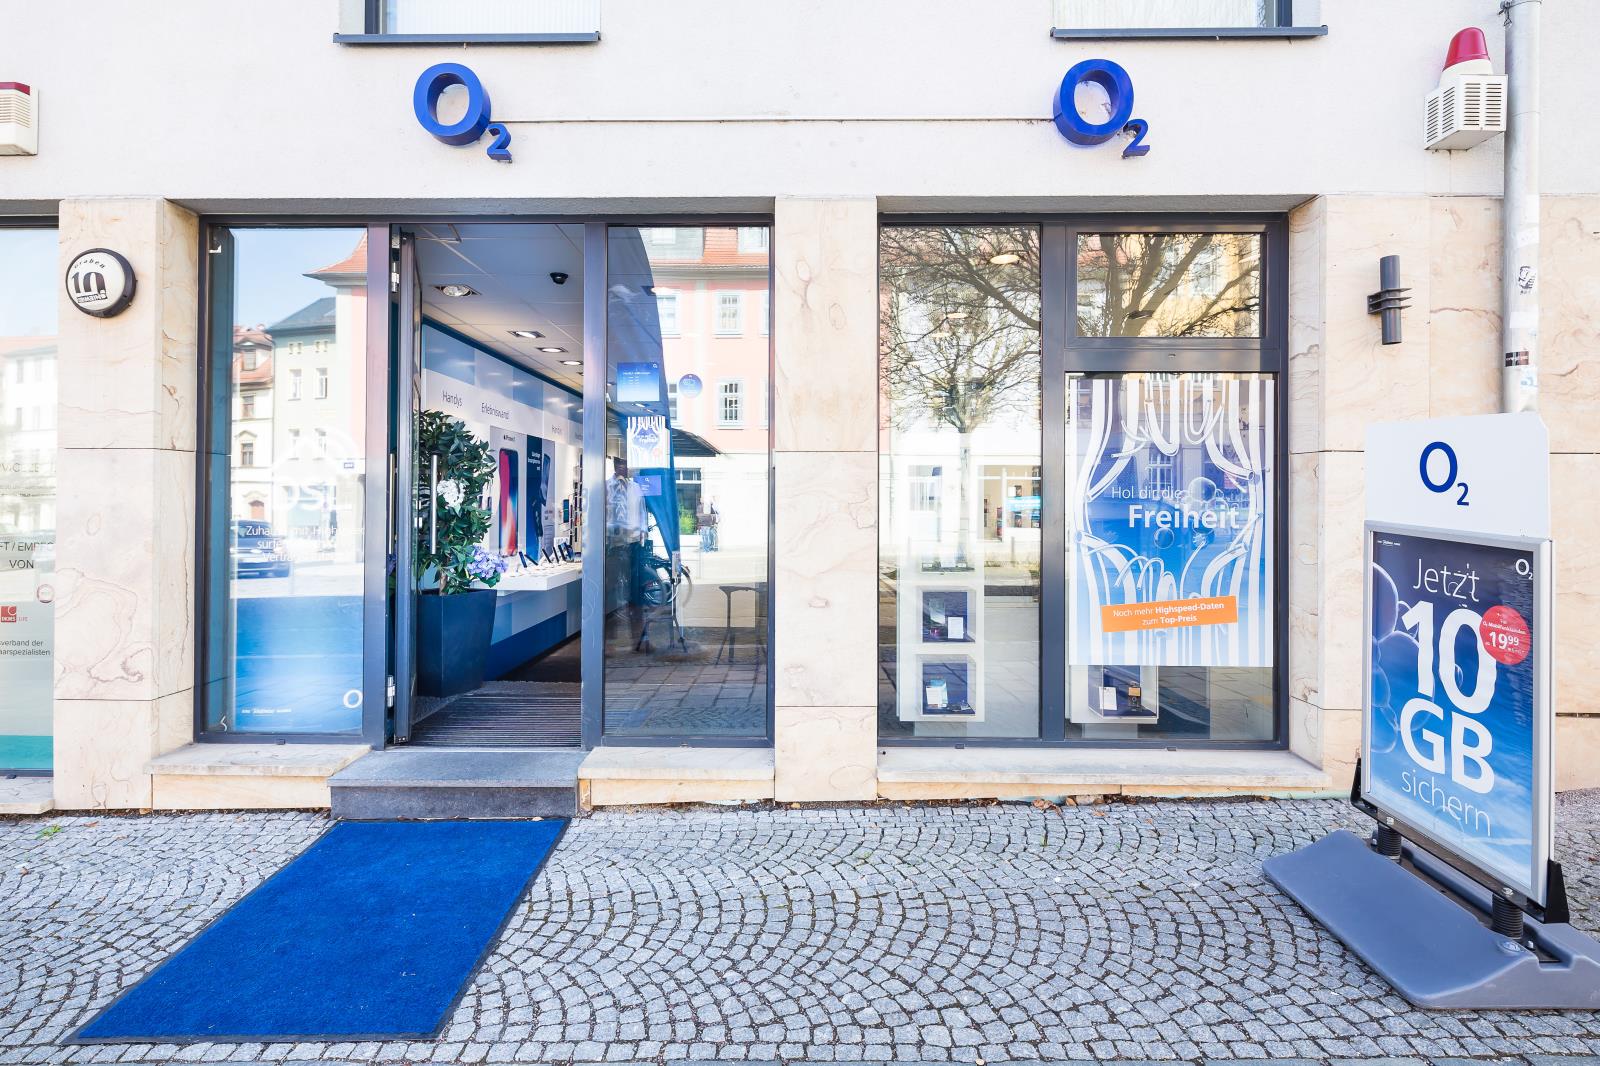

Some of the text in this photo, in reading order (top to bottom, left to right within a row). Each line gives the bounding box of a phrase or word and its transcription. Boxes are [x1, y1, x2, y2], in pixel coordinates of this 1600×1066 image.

[413, 62, 512, 160] O2
[1053, 59, 1150, 157] O2
[442, 390, 463, 408] Handys
[1419, 441, 1470, 506] O2
[1111, 486, 1183, 499] Hol dir die
[1129, 504, 1240, 529] Freiheit
[9, 559, 34, 569] VON
[1413, 559, 1480, 602] Jetzt
[1113, 602, 1225, 617] Noch mehr Highspeed-Daten
[1142, 615, 1198, 626] zum Top-Preis
[0, 639, 43, 647] verband der
[1402, 601, 1497, 714] 10
[1400, 697, 1495, 794] GB
[1401, 769, 1491, 837] sichern
